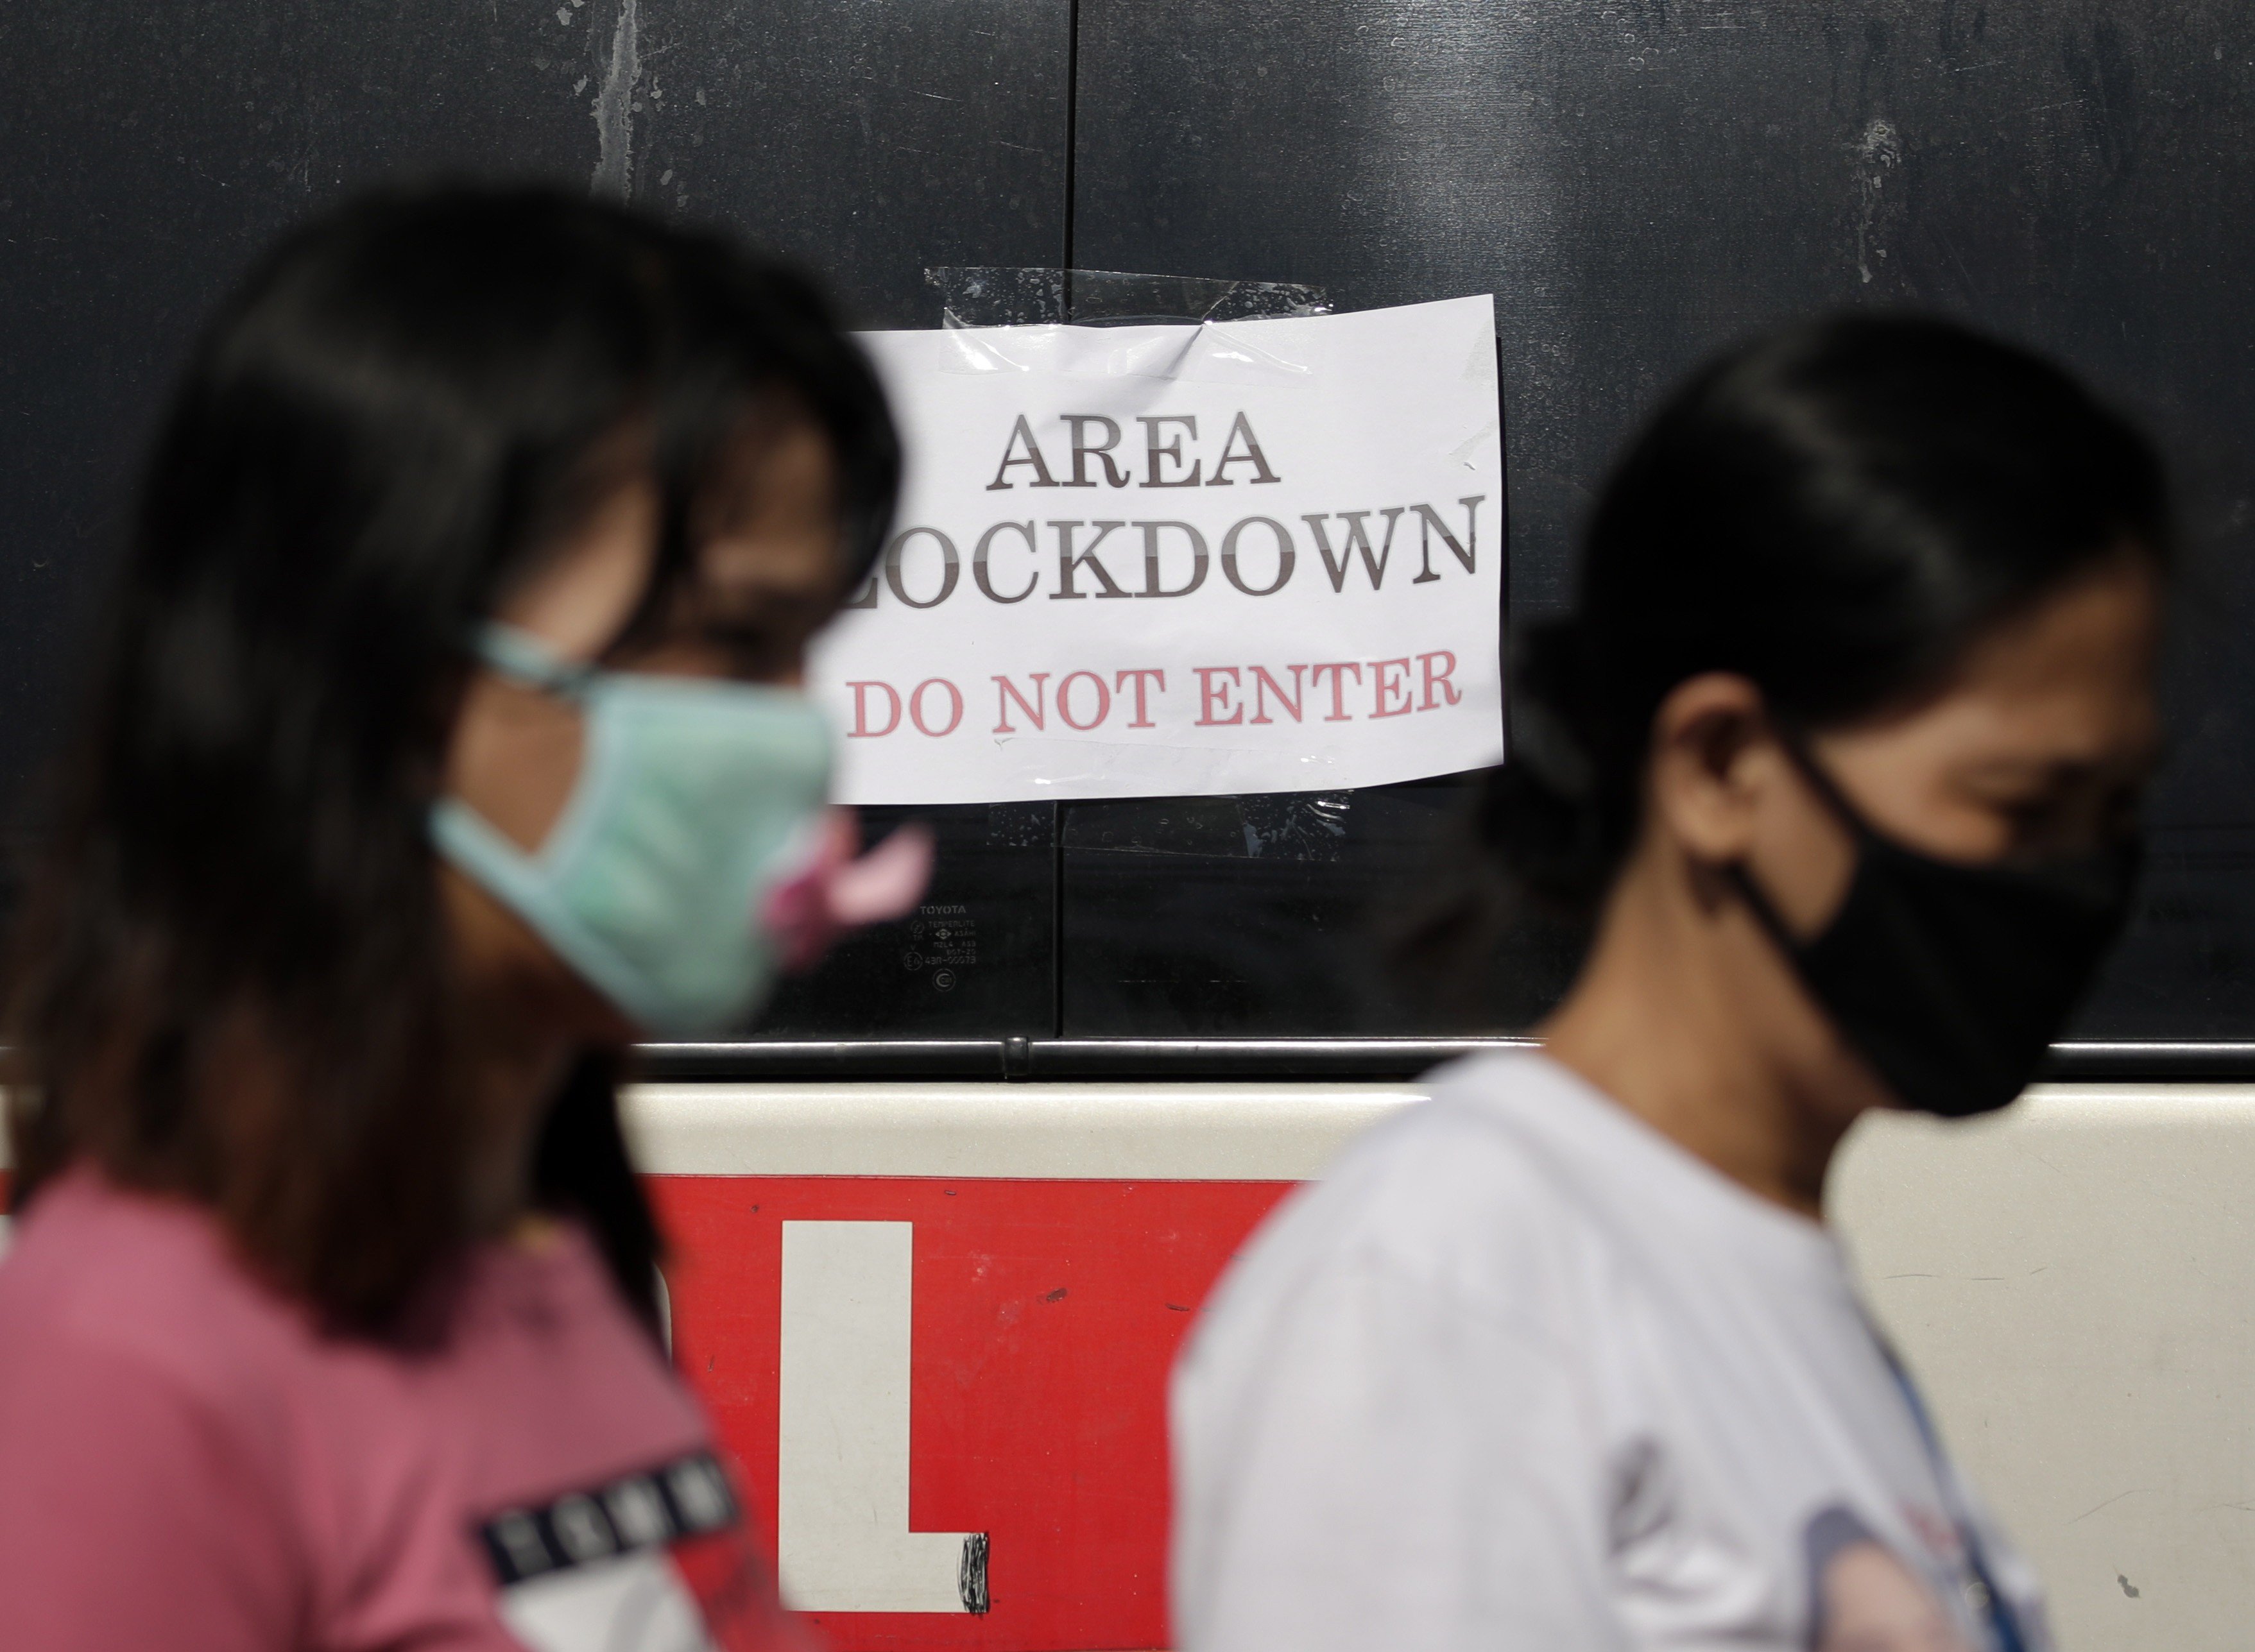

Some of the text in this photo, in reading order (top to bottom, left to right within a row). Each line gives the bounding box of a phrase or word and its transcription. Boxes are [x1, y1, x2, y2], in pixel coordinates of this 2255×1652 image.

[986, 411, 1281, 491] AREA
[846, 649, 1462, 738] DO NOT ENTER
[920, 905, 966, 914] TOYOTA
[655, 1219, 990, 1613] L
